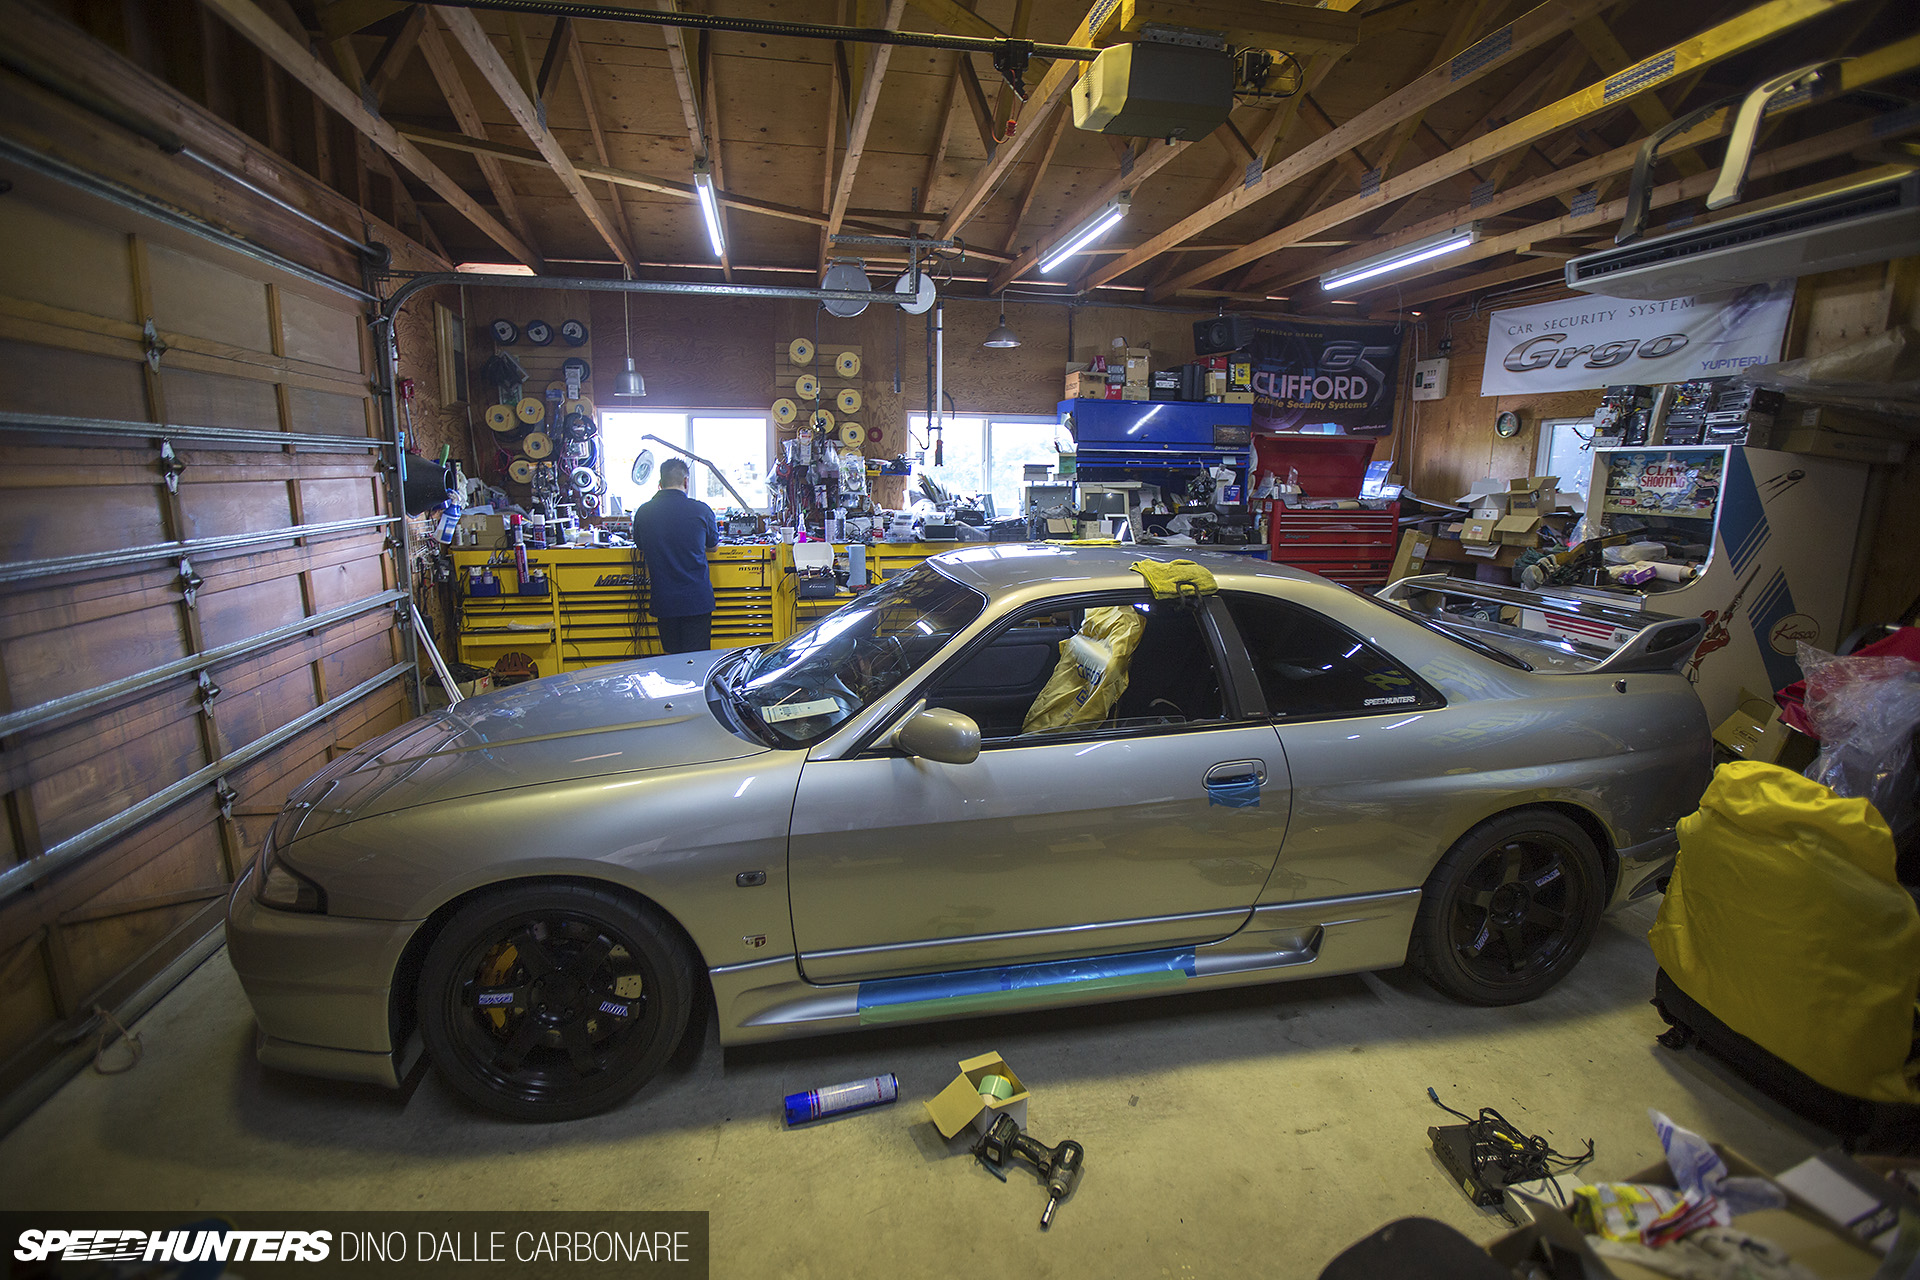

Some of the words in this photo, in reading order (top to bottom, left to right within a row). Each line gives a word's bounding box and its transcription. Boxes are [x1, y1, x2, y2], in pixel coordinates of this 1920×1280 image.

[1507, 323, 1533, 336] CAR
[1543, 309, 1618, 331] SECURITY
[1628, 296, 1695, 318] SYSTEM
[1253, 327, 1294, 337] THORIZED
[1502, 332, 1690, 373] Grgo
[1701, 354, 1769, 371] YUPITERU
[1252, 371, 1368, 400] CLIFFORD
[1287, 400, 1326, 411] Security
[1328, 400, 1368, 411] Systems
[1646, 465, 1685, 477] CLAY
[1640, 476, 1687, 488] SHOOTING
[1773, 623, 1817, 641] Kasco
[1364, 695, 1416, 706] SPEEDHUNTERS
